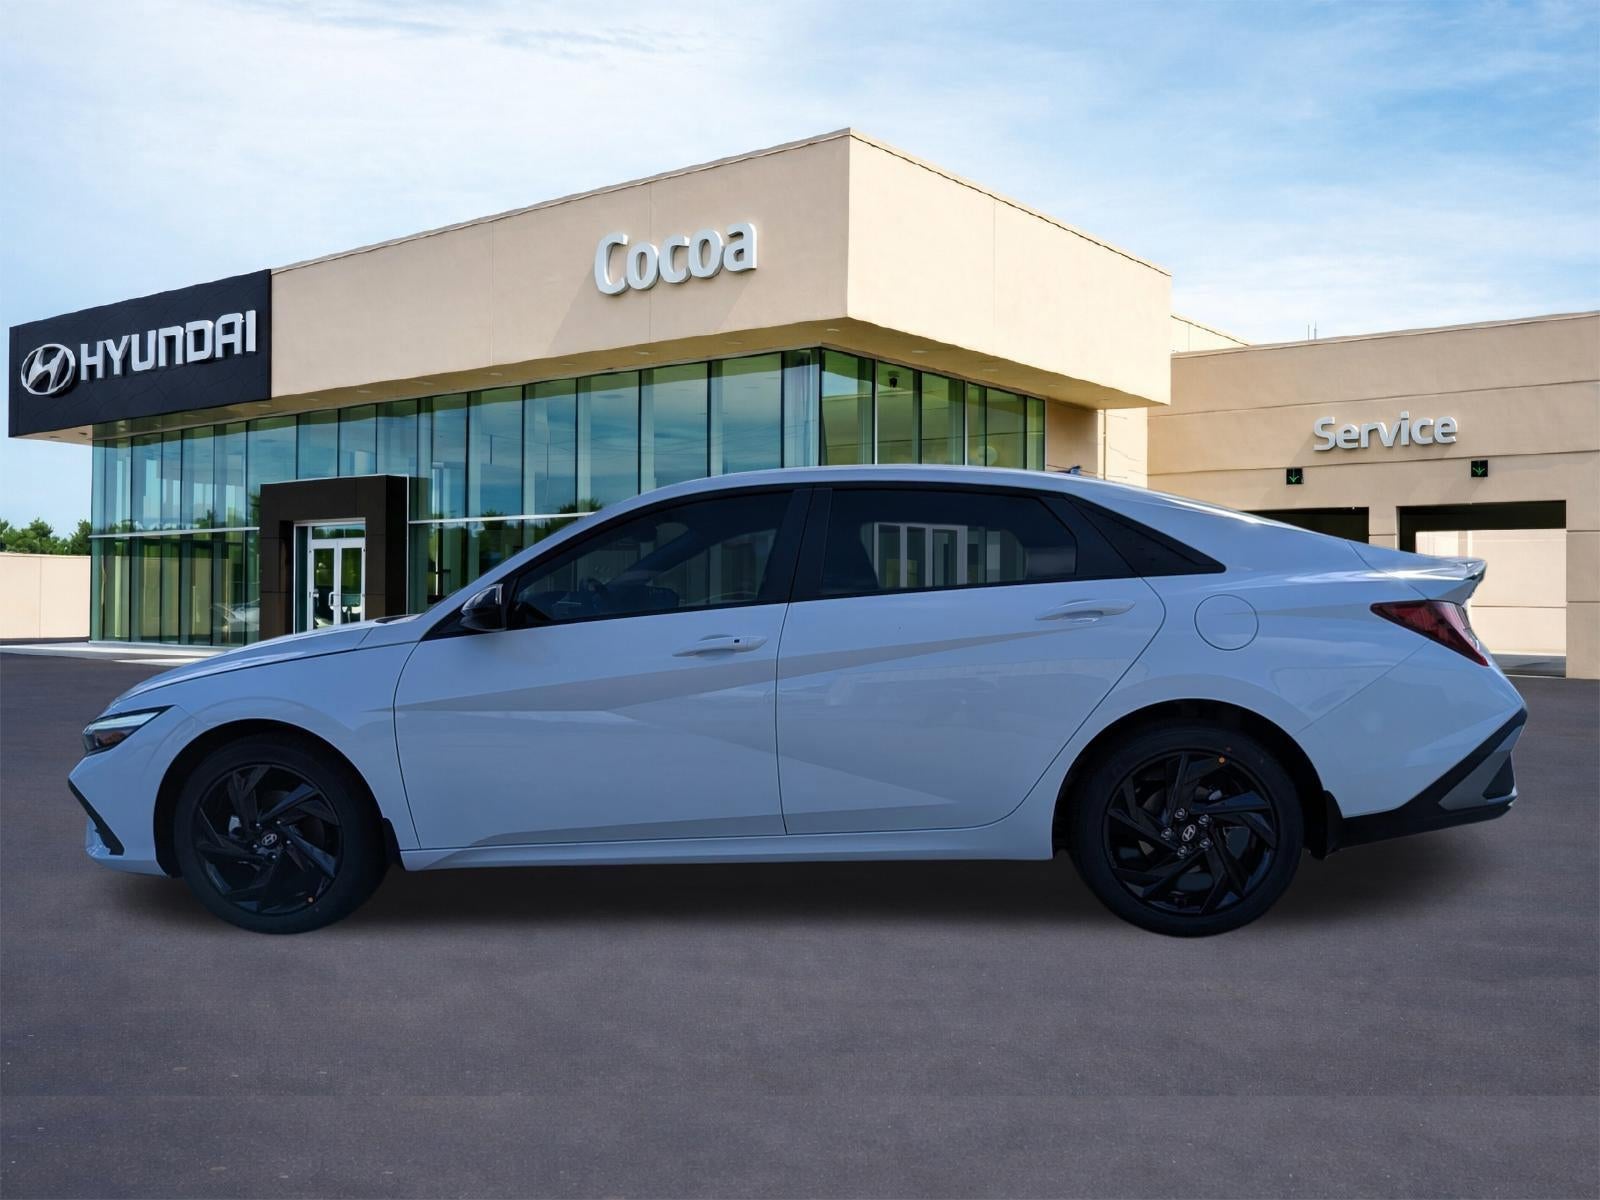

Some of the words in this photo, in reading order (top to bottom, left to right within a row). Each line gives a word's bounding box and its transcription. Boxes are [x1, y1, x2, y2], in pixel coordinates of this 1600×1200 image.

[594, 223, 758, 296] Cocoa
[80, 309, 256, 381] HYUNDAI
[1313, 411, 1458, 451] Service
